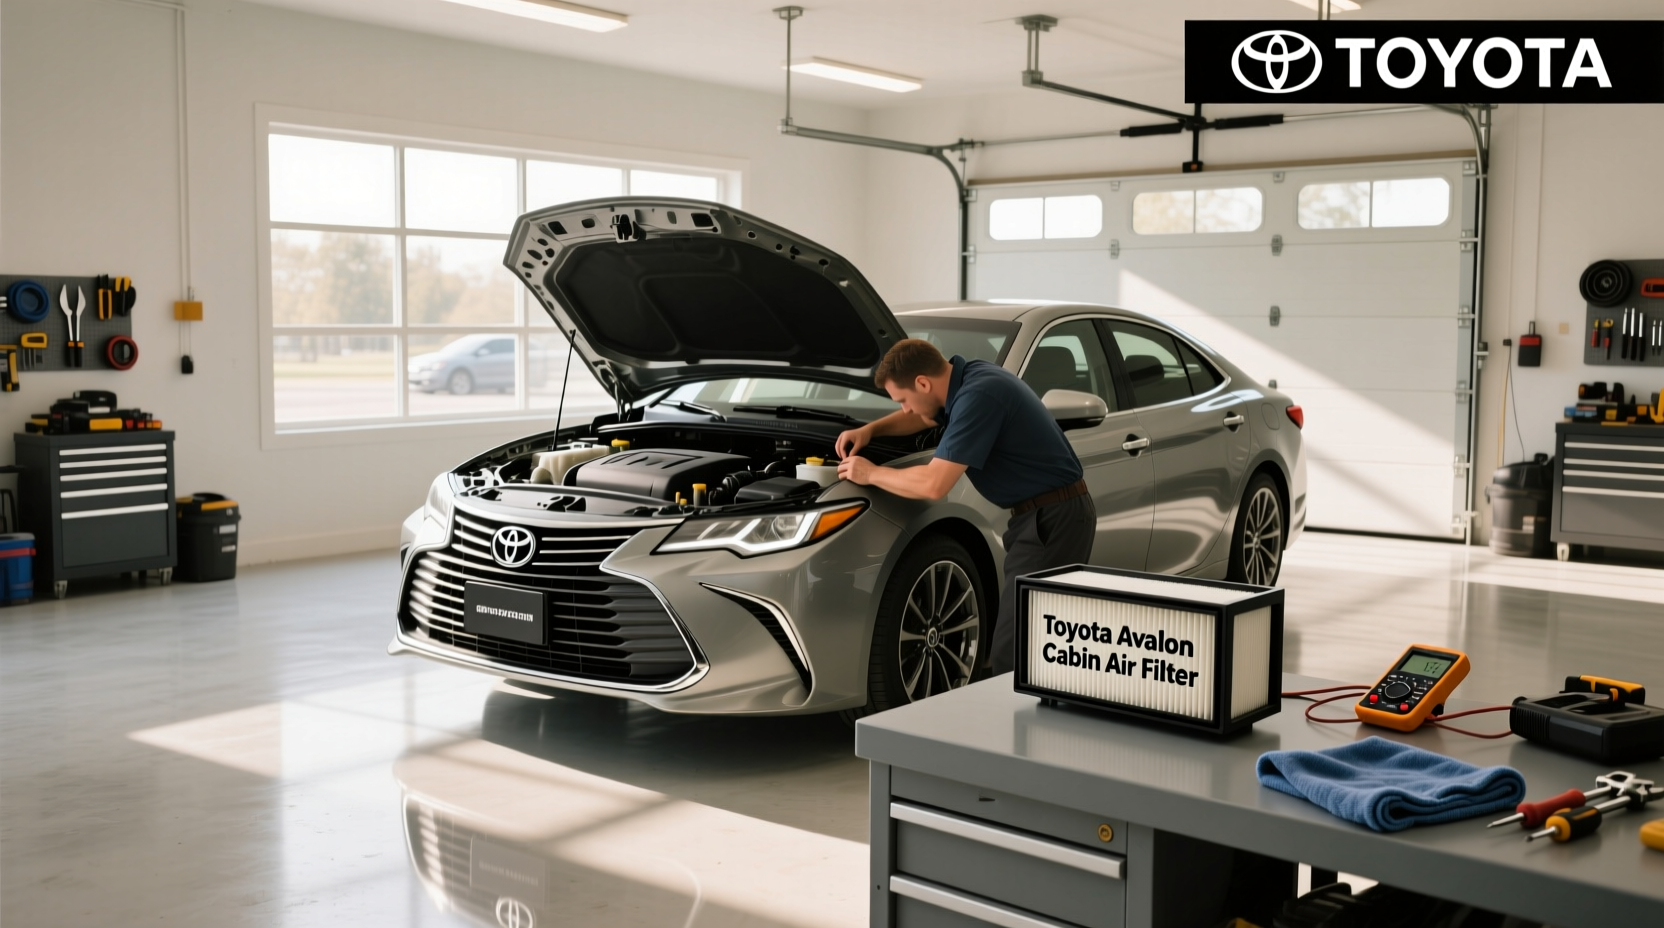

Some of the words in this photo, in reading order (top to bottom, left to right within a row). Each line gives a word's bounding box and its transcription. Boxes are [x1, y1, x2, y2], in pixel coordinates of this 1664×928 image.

[1043, 614, 1112, 645] Toyota
[1116, 625, 1194, 658] Avalon
[1042, 642, 1101, 671] Cabin
[1105, 652, 1137, 677] Air
[1141, 657, 1199, 687] Filter
